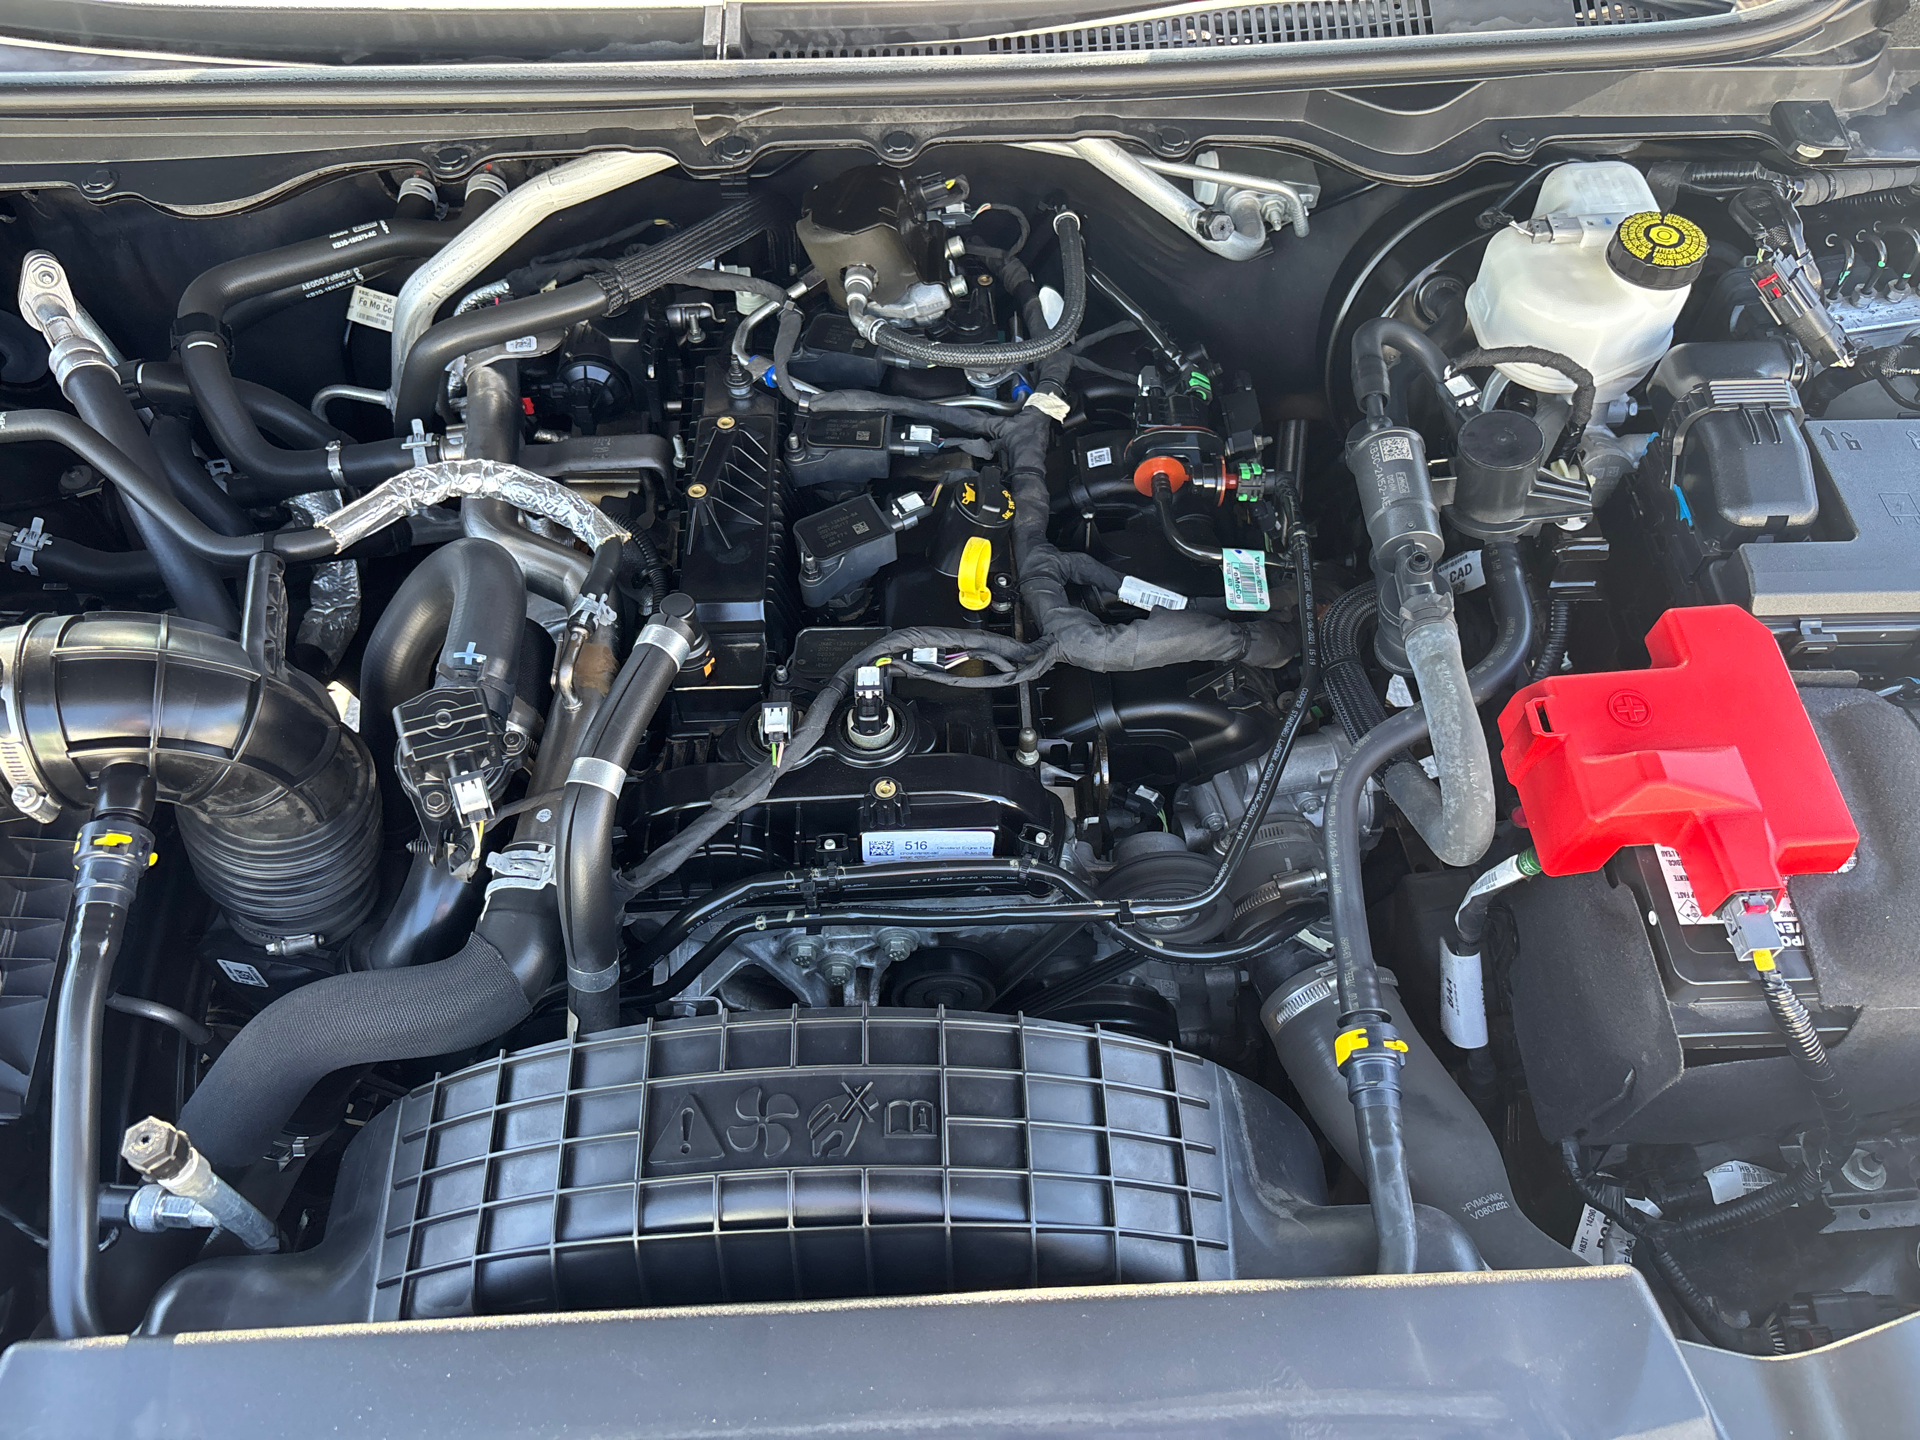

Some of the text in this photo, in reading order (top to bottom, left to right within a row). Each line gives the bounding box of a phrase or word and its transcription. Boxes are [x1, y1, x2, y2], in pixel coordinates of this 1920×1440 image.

[370, 300, 380, 310] Mo
[382, 304, 392, 314] Co
[1449, 562, 1472, 583] CAD
[1298, 688, 1308, 709] COOPER
[904, 841, 928, 851] 516
[1578, 1236, 1588, 1254] HB3T
[1586, 1209, 1596, 1228] 14290
